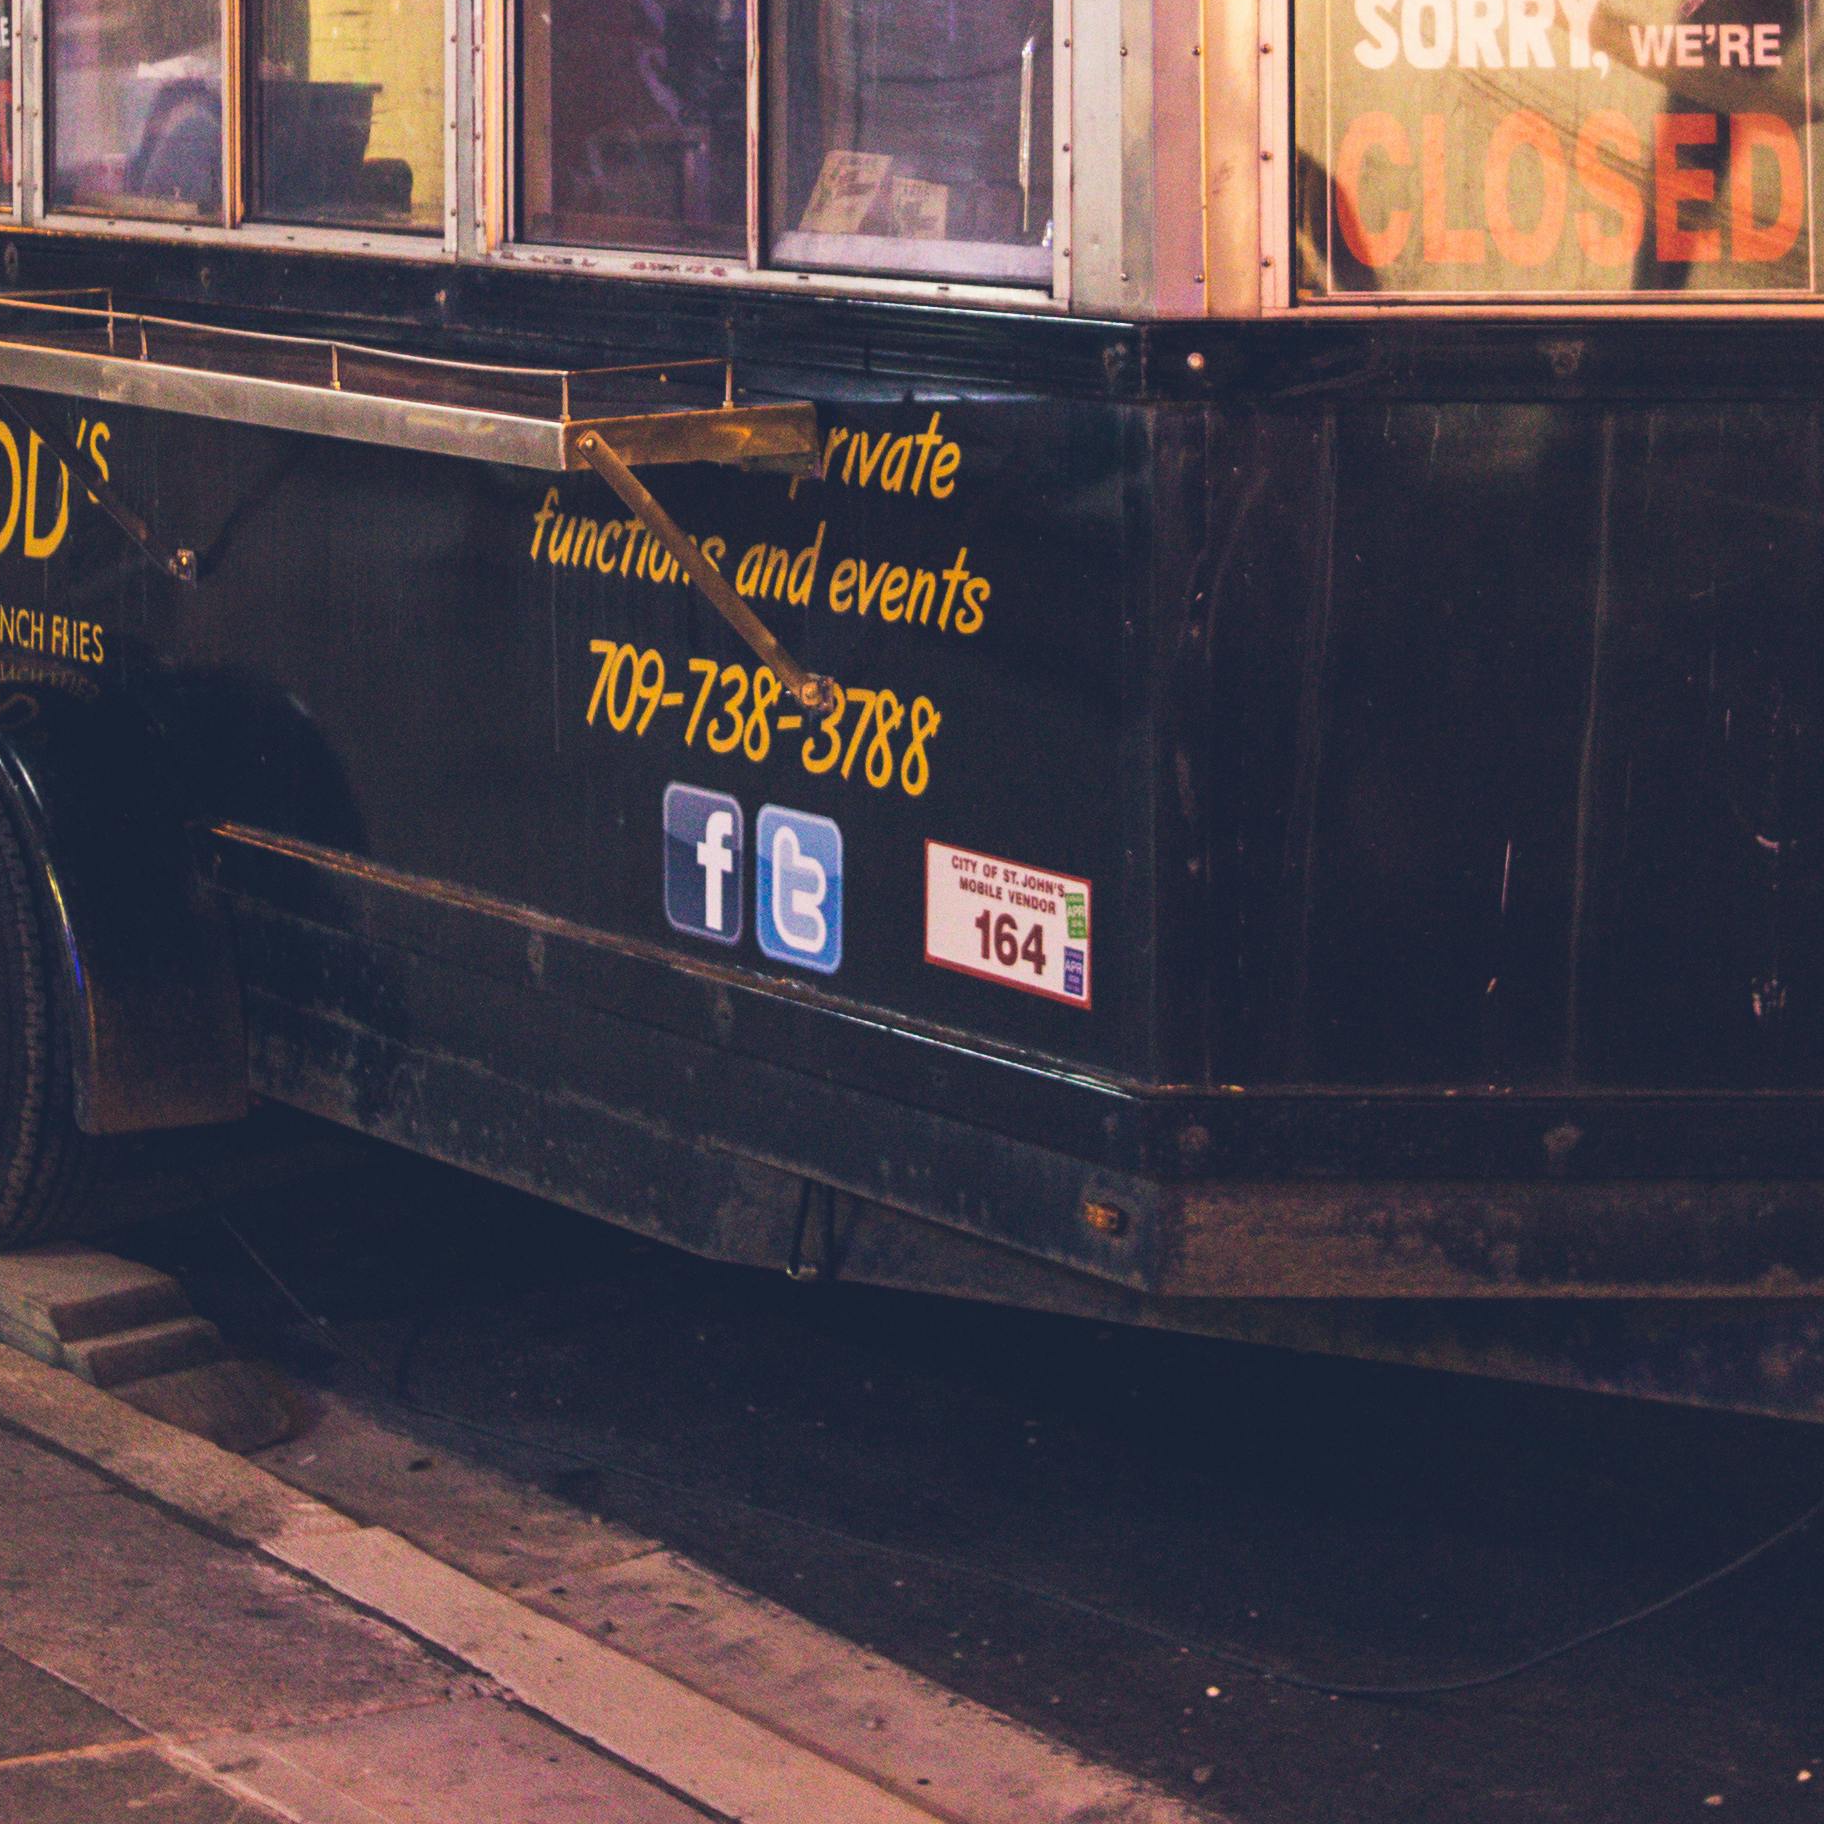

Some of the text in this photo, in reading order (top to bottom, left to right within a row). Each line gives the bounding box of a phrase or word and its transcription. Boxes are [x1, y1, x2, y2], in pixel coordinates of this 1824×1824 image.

[1630, 22, 1783, 68] WE'RE
[1335, 110, 1805, 268] CLOSED
[788, 411, 962, 500] rivate
[735, 520, 826, 606] and
[829, 547, 991, 635] events
[51, 614, 105, 665] FRIES
[585, 639, 941, 797] 709-738-3788
[951, 855, 1065, 898] CITY OF ST. JOHN'S
[959, 876, 1003, 901] MOBILE
[1008, 889, 1057, 915] VENDOR
[974, 909, 1046, 975] 164
